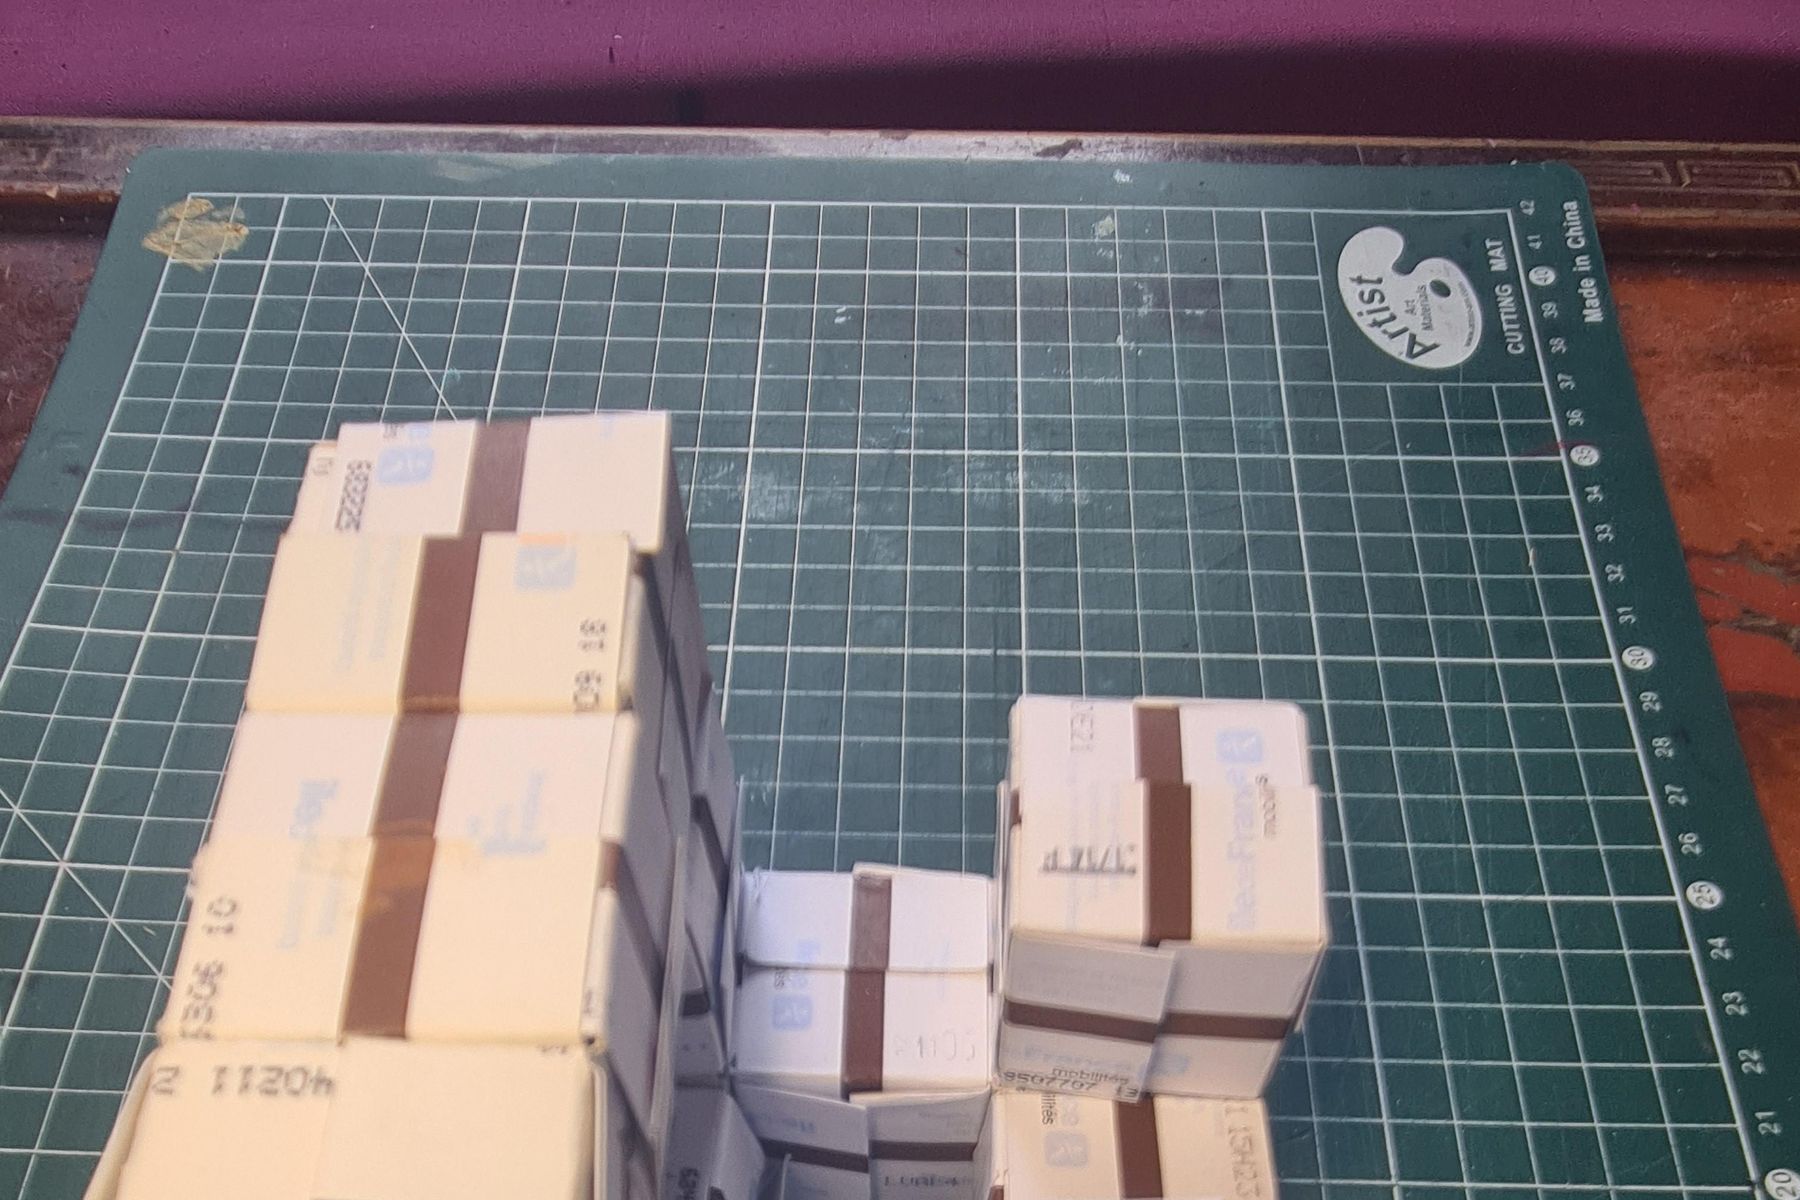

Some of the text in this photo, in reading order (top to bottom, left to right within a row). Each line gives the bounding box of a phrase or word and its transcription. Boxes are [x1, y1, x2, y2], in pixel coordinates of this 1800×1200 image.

[1519, 200, 1535, 216] 42
[1526, 234, 1543, 250] 41
[1562, 200, 1604, 323] Made in China
[1533, 268, 1550, 284] 40
[1485, 238, 1525, 355] CUTTING MAT
[1349, 275, 1441, 359] Artist
[1417, 284, 1434, 331] Materials
[1541, 301, 1559, 319] 39
[1549, 337, 1567, 354] 38
[1557, 373, 1576, 390] 37
[1566, 409, 1585, 426] 36
[1577, 447, 1594, 464] 35
[1584, 485, 1604, 503] 34
[1594, 523, 1615, 542] 33
[1604, 564, 1625, 582] 32
[1616, 606, 1636, 624] 31
[1630, 649, 1648, 668] 30
[1639, 691, 1661, 712] 29
[1651, 736, 1674, 758] 28
[1664, 784, 1688, 806] 27
[1678, 832, 1702, 855] 26
[1696, 884, 1717, 906] 25
[1707, 937, 1732, 960] 24
[1721, 991, 1748, 1016] 23
[1737, 1049, 1765, 1074] 22
[1754, 1111, 1782, 1135] 21
[1772, 1171, 1797, 1198] 20
